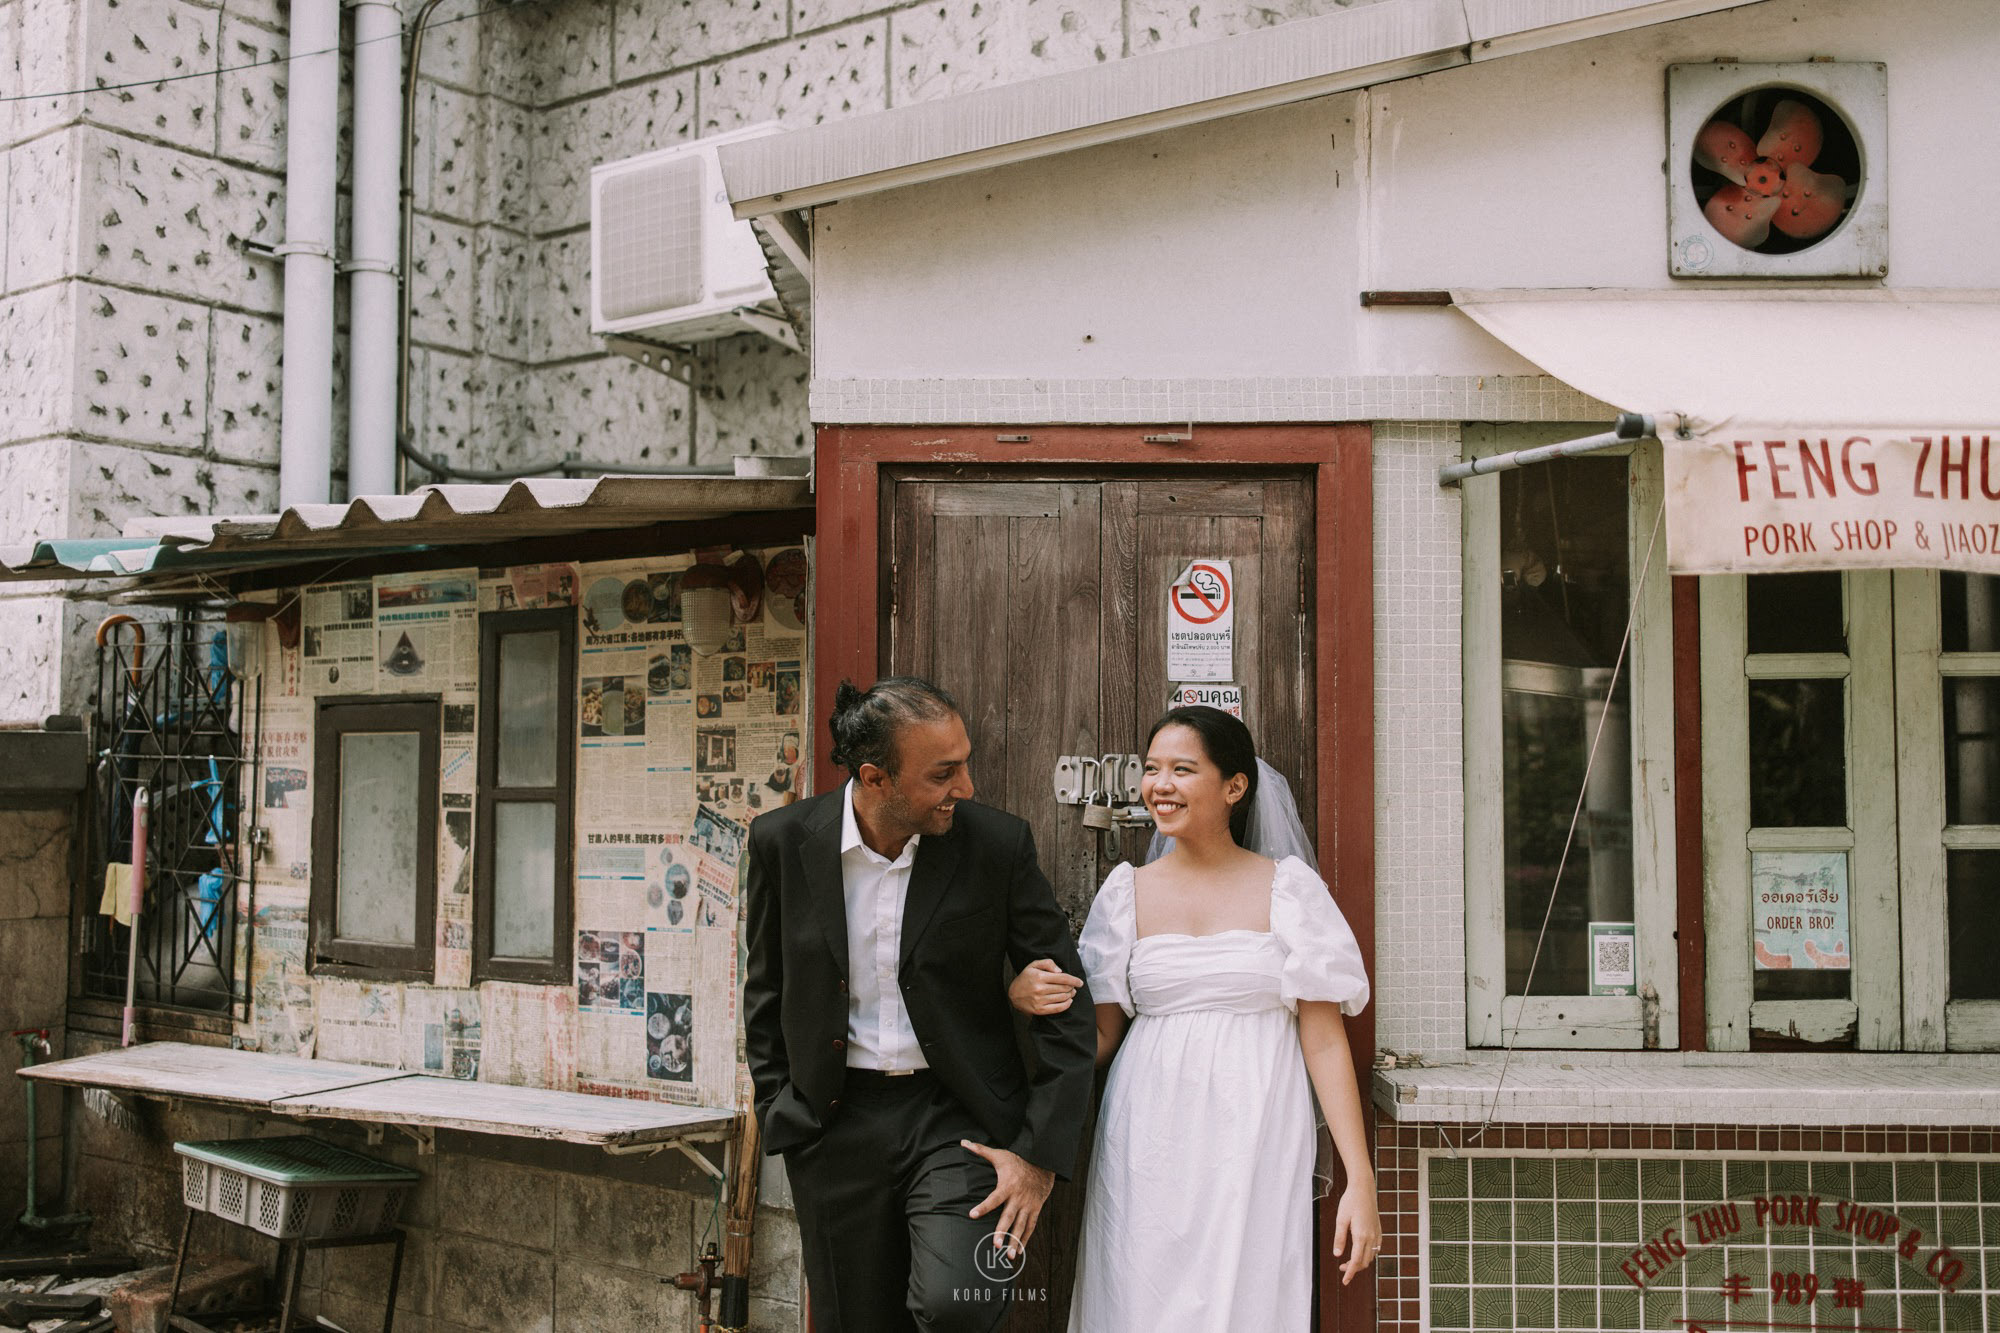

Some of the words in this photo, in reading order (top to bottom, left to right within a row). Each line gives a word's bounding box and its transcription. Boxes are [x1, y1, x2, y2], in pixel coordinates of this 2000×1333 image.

[1733, 436, 1879, 502] FENG
[1910, 435, 2000, 501] ZHU
[1744, 522, 1817, 556] PORK
[1832, 520, 1898, 551] SHOP
[1915, 520, 1931, 550] &
[1941, 522, 2000, 560] JIAOZ
[1171, 626, 1231, 645] เขตปลอดบุหรี่
[1761, 889, 1839, 904] ออเดอร์เฮีย
[1767, 916, 1803, 930] ORDER
[1809, 916, 1834, 930] BRO!
[1620, 1228, 1687, 1289] FENG
[1688, 1203, 1742, 1245] ZHU
[1753, 1195, 1822, 1228] PORK
[1833, 1201, 1900, 1245] SHOP
[1898, 1228, 1923, 1260] &
[1926, 1248, 1966, 1293] CO.
[1770, 1272, 1819, 1306] 989
